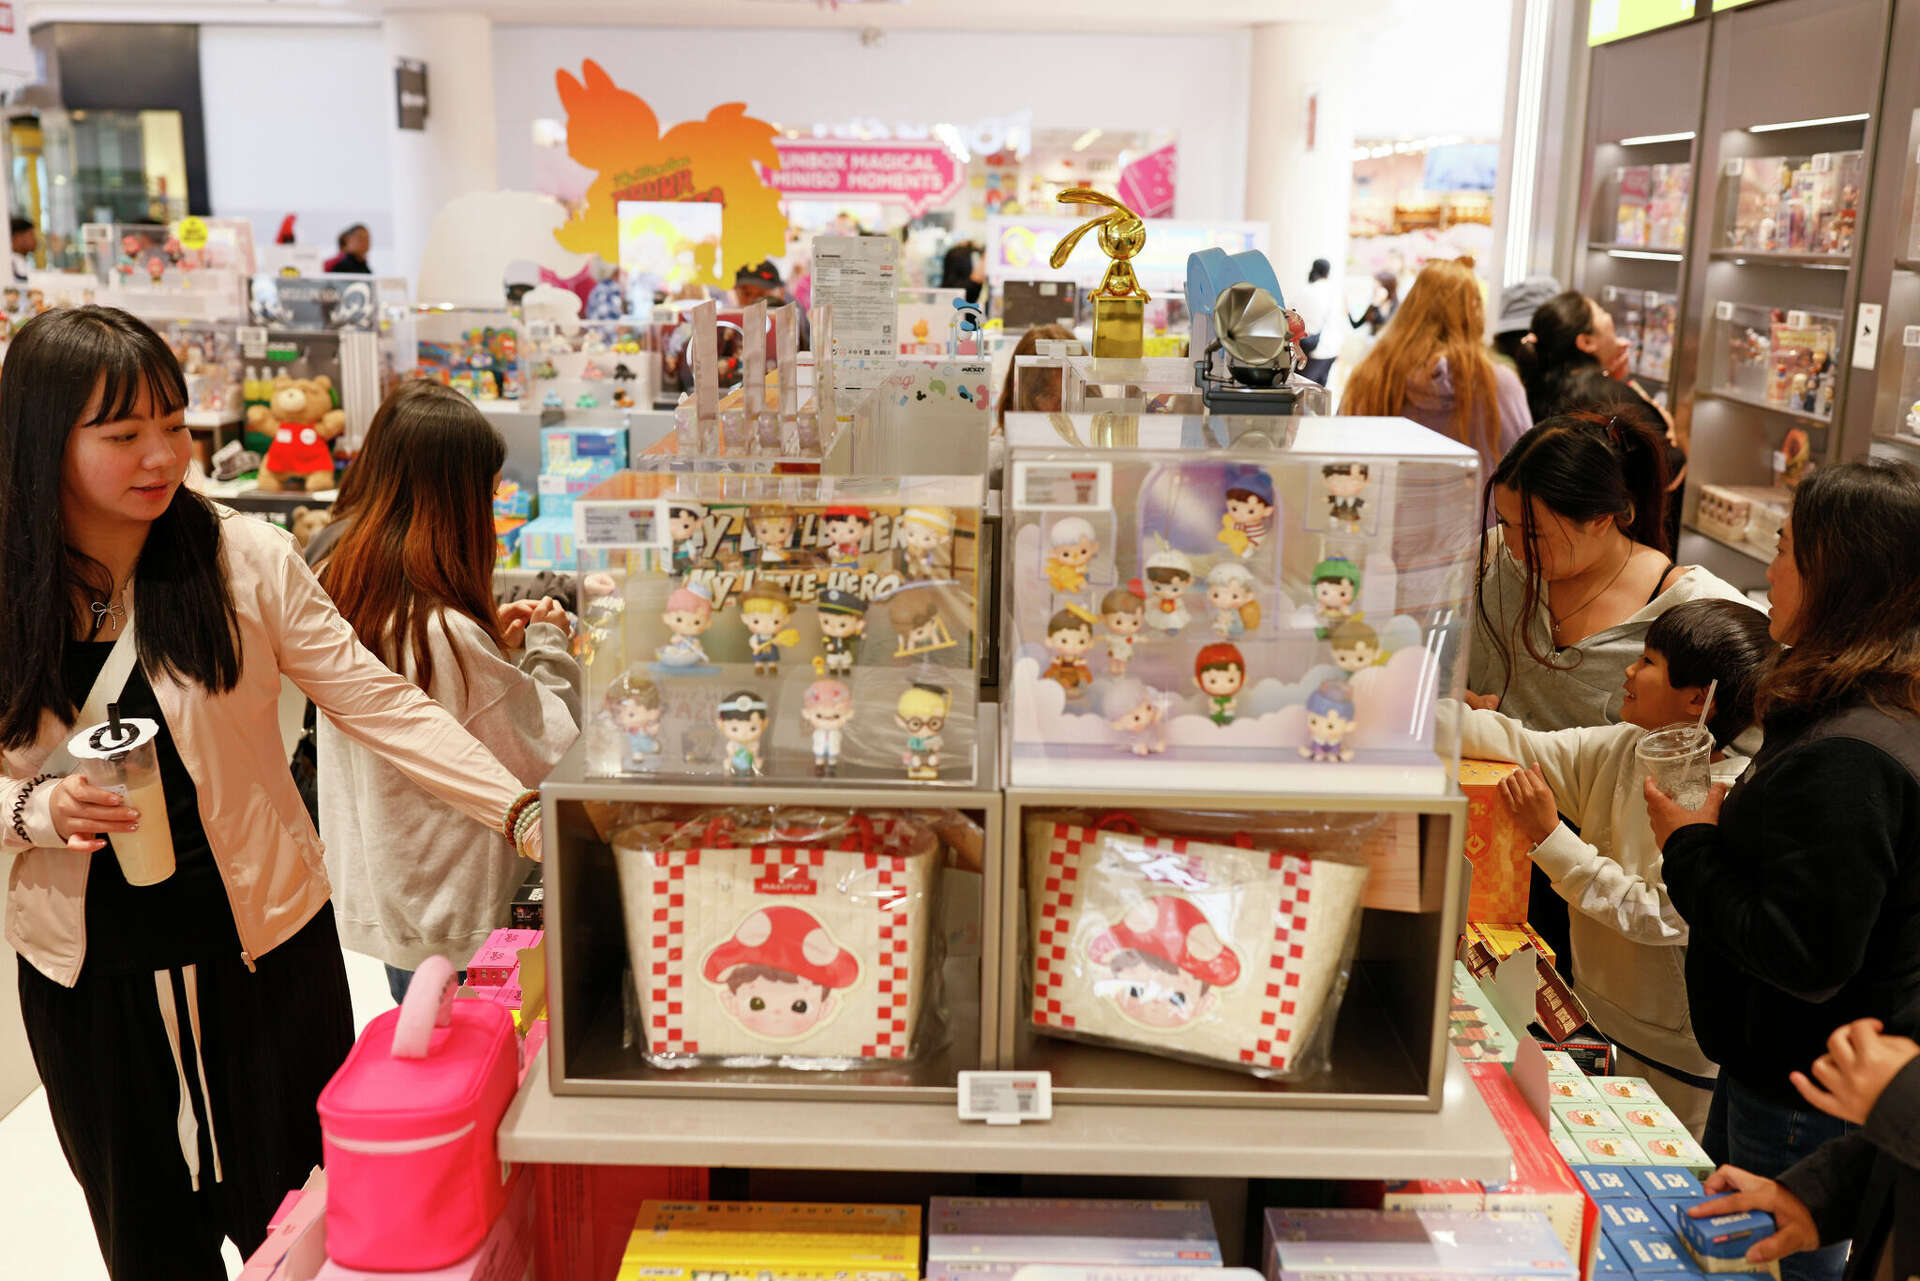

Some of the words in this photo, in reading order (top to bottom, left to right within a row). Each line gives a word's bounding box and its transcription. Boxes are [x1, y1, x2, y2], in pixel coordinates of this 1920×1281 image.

[780, 152, 847, 170] UNBOX
[850, 153, 936, 172] MAGICAL
[771, 171, 842, 189] MINISO
[846, 172, 944, 191] MOMENTS
[826, 571, 902, 602] HERO
